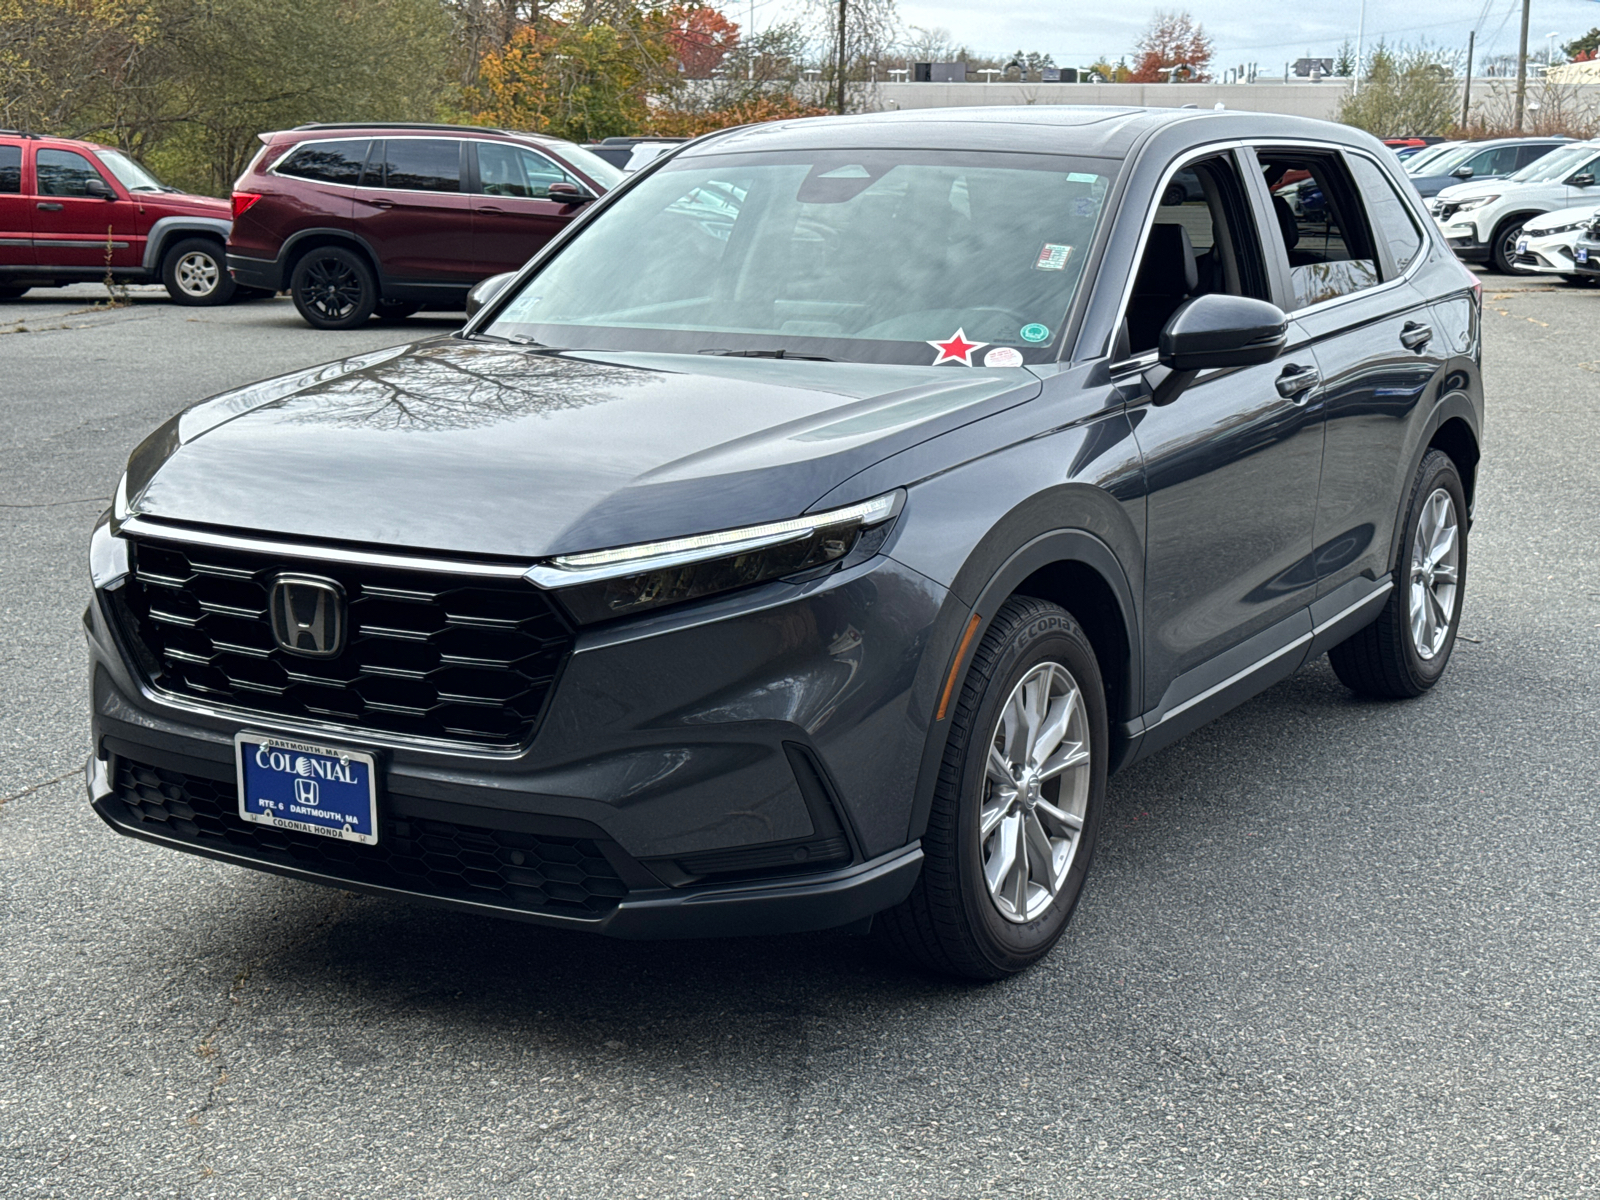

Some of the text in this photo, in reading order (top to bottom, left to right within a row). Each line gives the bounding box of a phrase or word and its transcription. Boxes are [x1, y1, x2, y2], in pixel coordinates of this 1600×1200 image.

[325, 748, 339, 757] MA
[255, 750, 358, 784] COLONIAL
[258, 798, 284, 810] RTE. 6
[290, 804, 359, 824] DARTMOUTH, MA
[272, 818, 344, 838] COLONIAL HONDA
